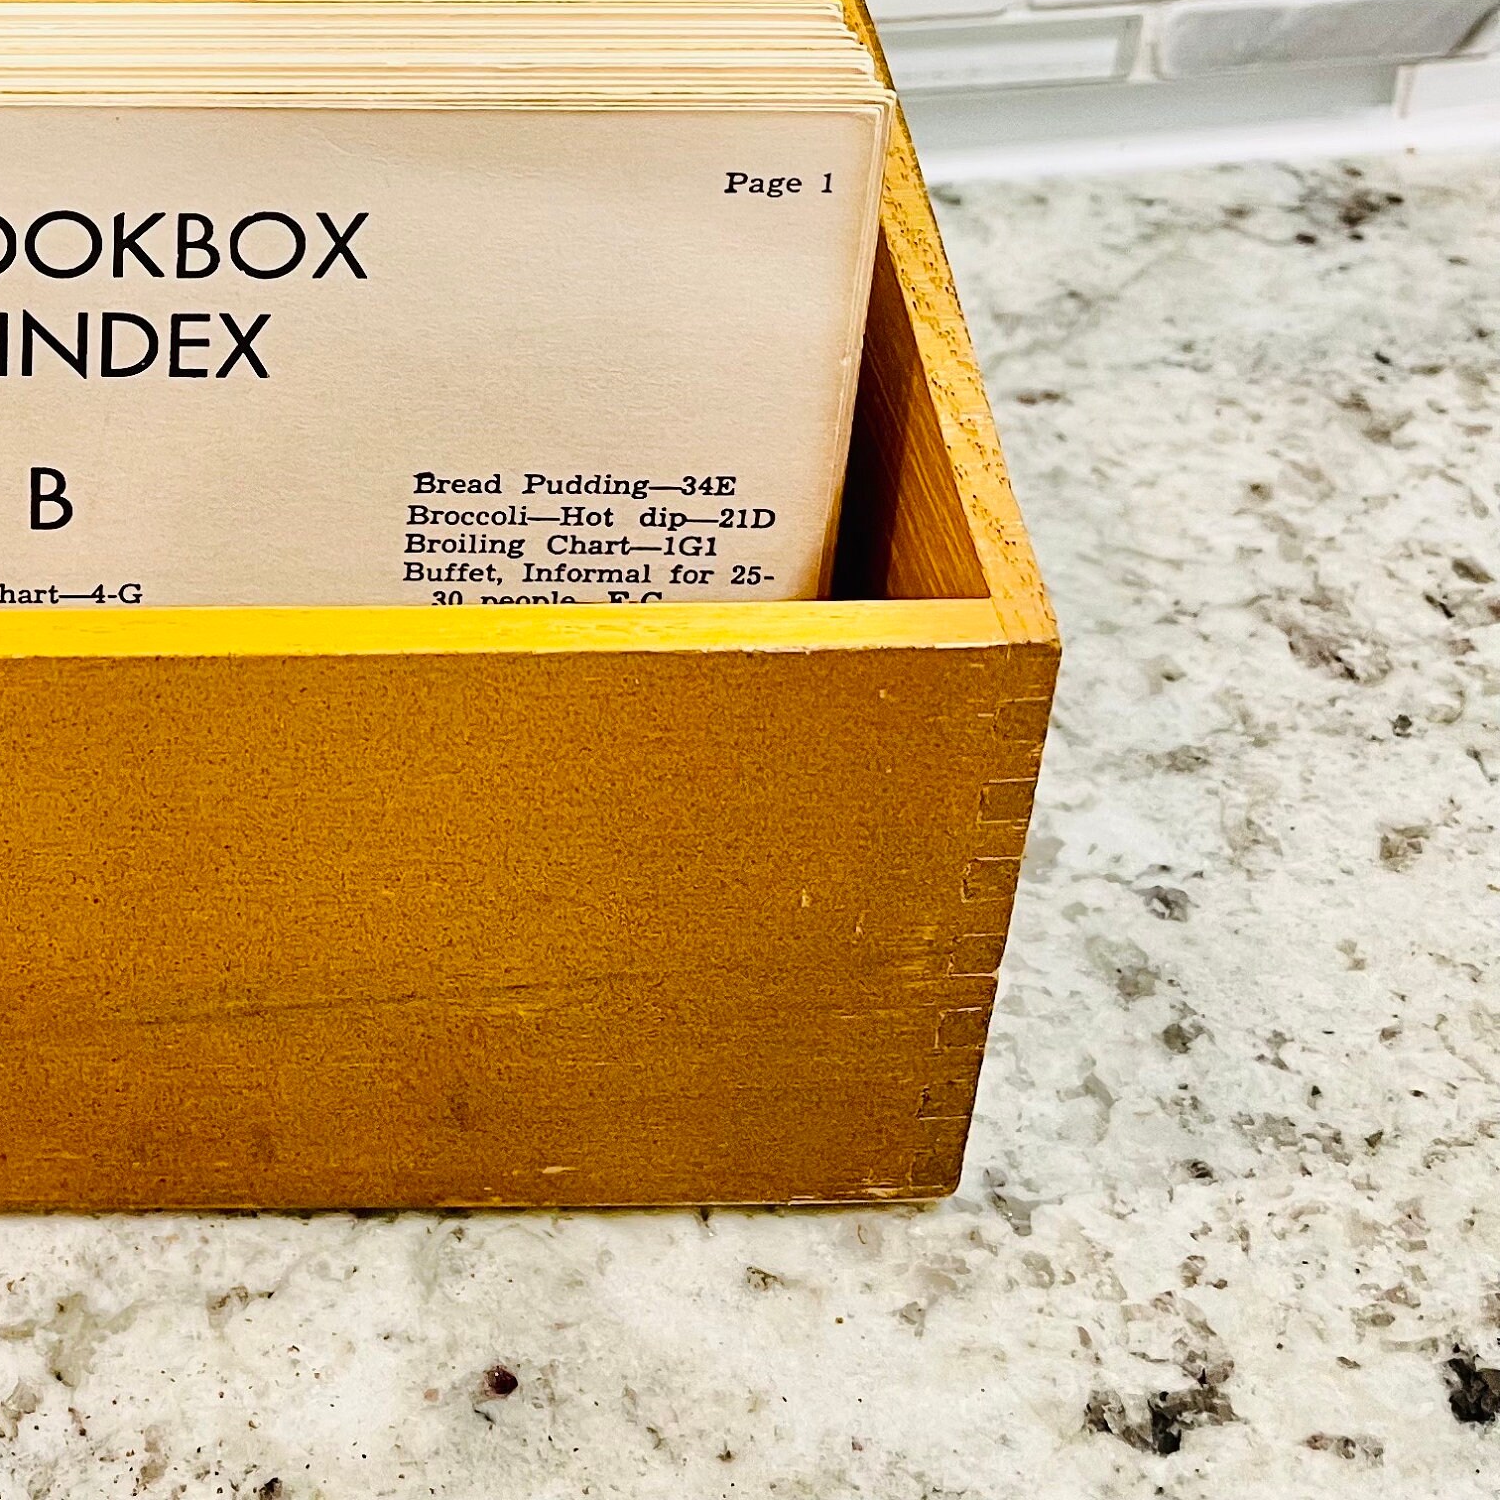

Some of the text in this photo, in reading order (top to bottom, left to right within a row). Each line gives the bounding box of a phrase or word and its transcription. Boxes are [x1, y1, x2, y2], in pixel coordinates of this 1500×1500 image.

[723, 172, 833, 198] Page 1
[412, 471, 503, 495] Bread
[30, 466, 73, 531] B
[403, 533, 526, 560] Broiling
[402, 561, 503, 586] Buffet,
[521, 562, 652, 584] Informal
[668, 563, 715, 585] for
[431, 590, 463, 606] 30
